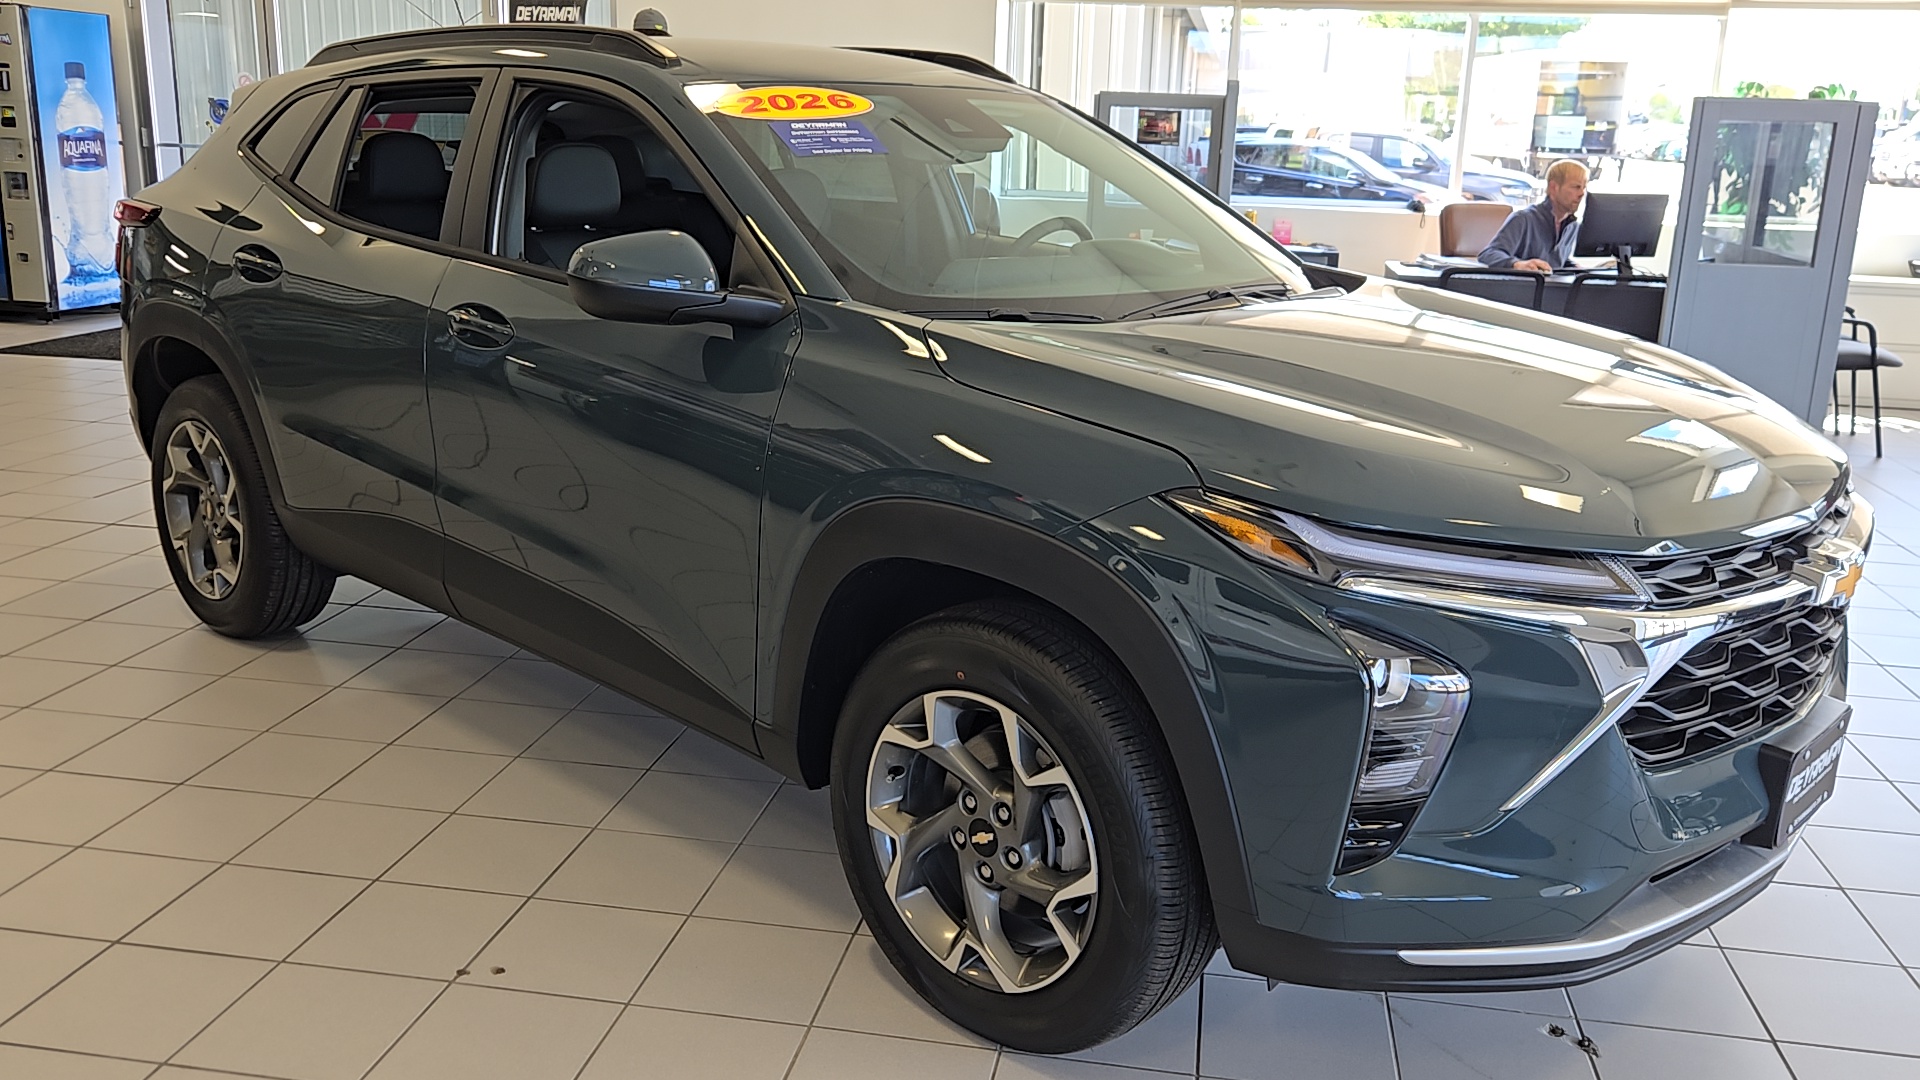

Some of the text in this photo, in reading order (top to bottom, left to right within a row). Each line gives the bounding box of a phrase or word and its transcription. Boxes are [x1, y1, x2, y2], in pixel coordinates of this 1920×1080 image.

[515, 5, 581, 22] DEYARMAN
[737, 93, 857, 114] 2026
[63, 138, 104, 158] AQUAFINA
[1785, 736, 1845, 803] DEYARMAN
